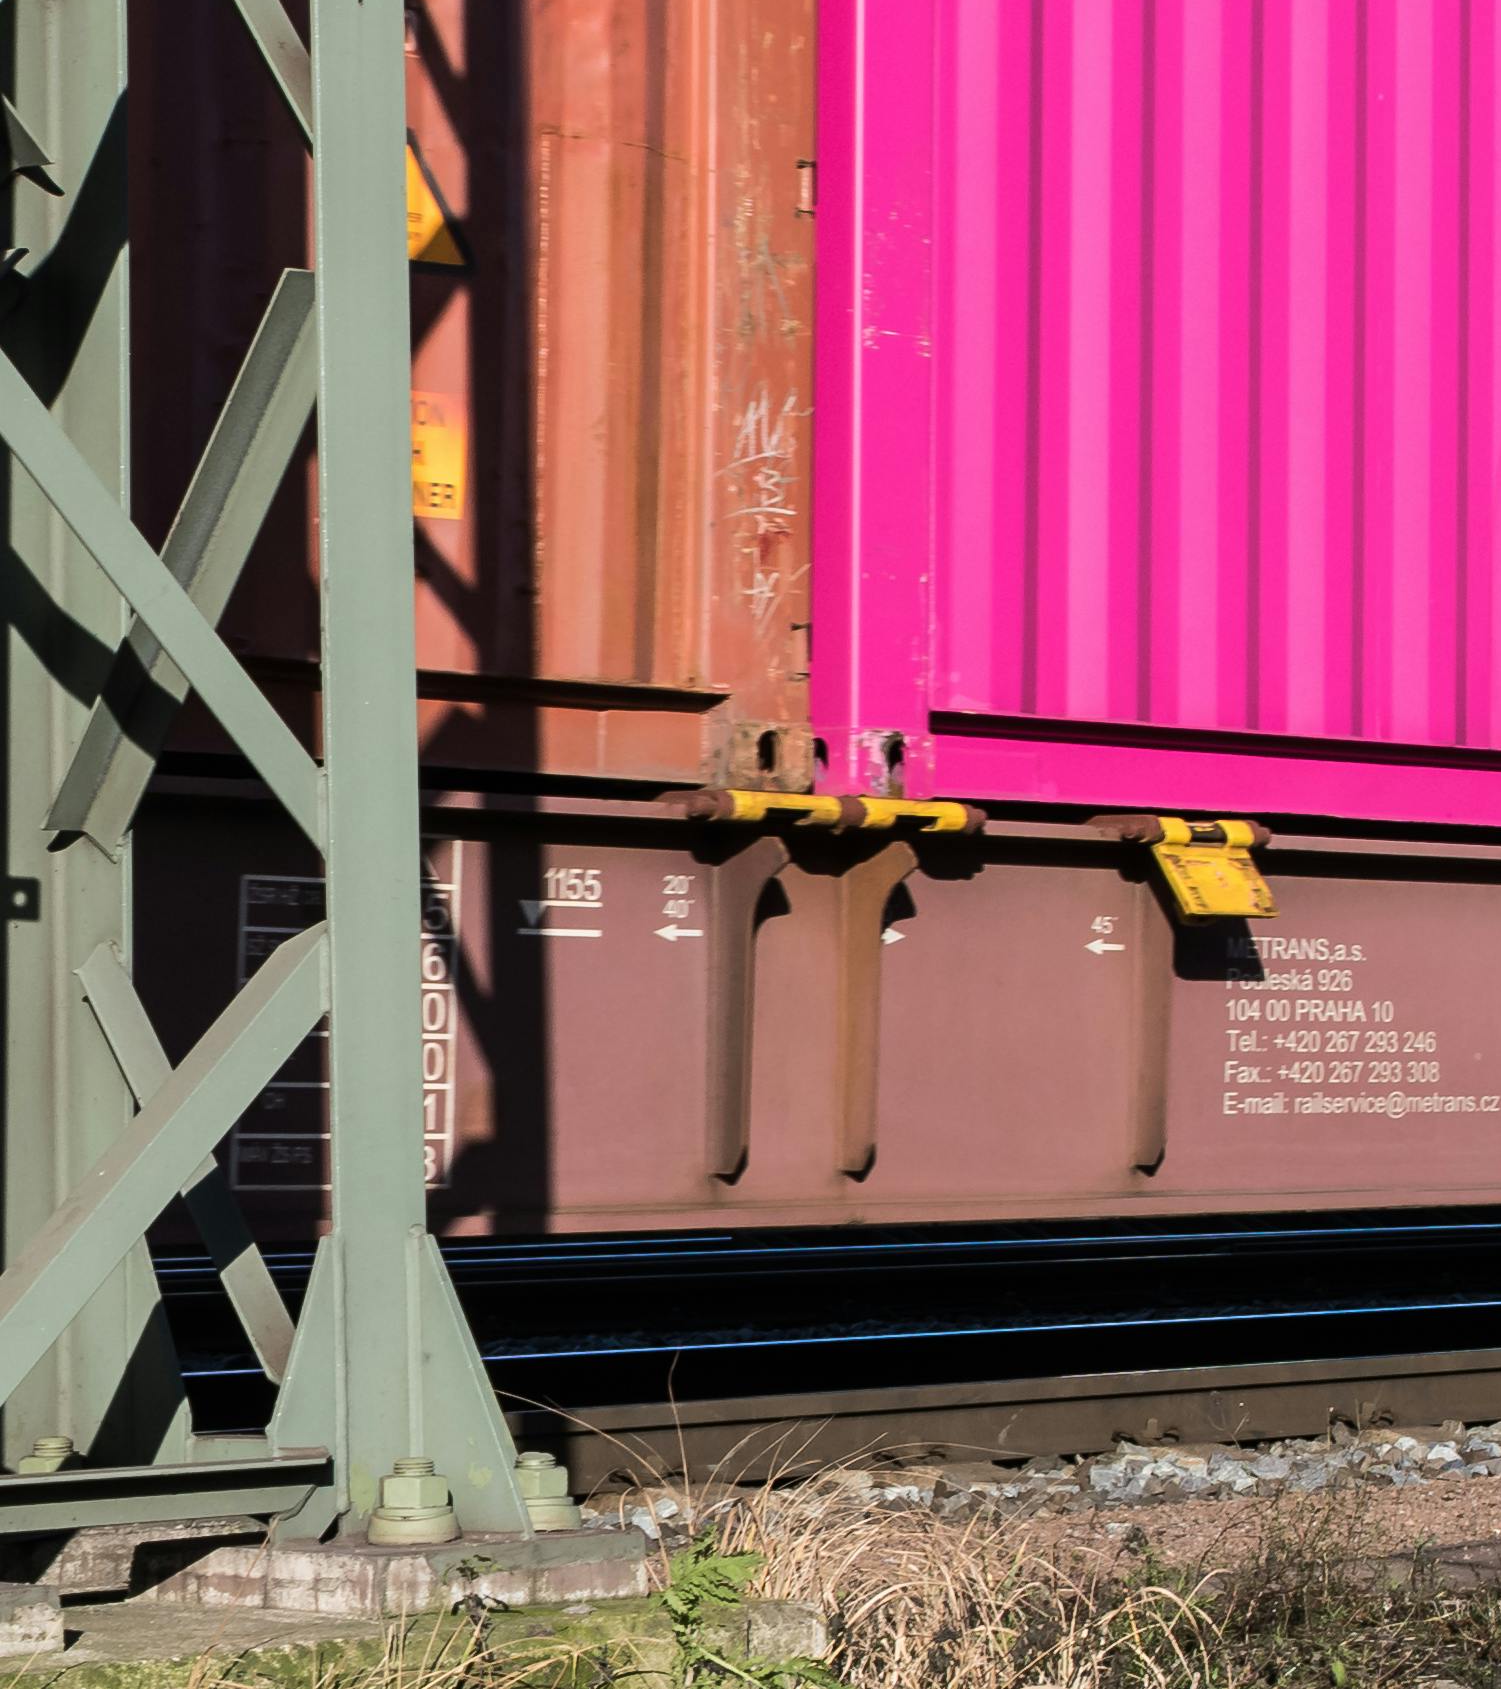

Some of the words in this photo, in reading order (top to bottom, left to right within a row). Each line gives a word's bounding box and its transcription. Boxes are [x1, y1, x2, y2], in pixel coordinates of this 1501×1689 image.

[544, 867, 603, 901] 1155
[1317, 969, 1353, 992] 926
[1225, 999, 1262, 1022] 104
[1265, 999, 1291, 1022] 00
[1295, 1000, 1367, 1022] PRAHA
[1371, 1000, 1394, 1022] 10
[1272, 1031, 1321, 1052] +420
[1324, 1031, 1359, 1052] 267
[1363, 1031, 1399, 1052] 293
[1402, 1031, 1437, 1053] 246
[1277, 1062, 1324, 1083] +420
[1328, 1061, 1362, 1083] 267
[1367, 1061, 1403, 1083] 293
[1406, 1061, 1440, 1083] 308
[1222, 1091, 1289, 1115] E-mail:
[1293, 1091, 1501, 1119] railservice@metrans.cz
